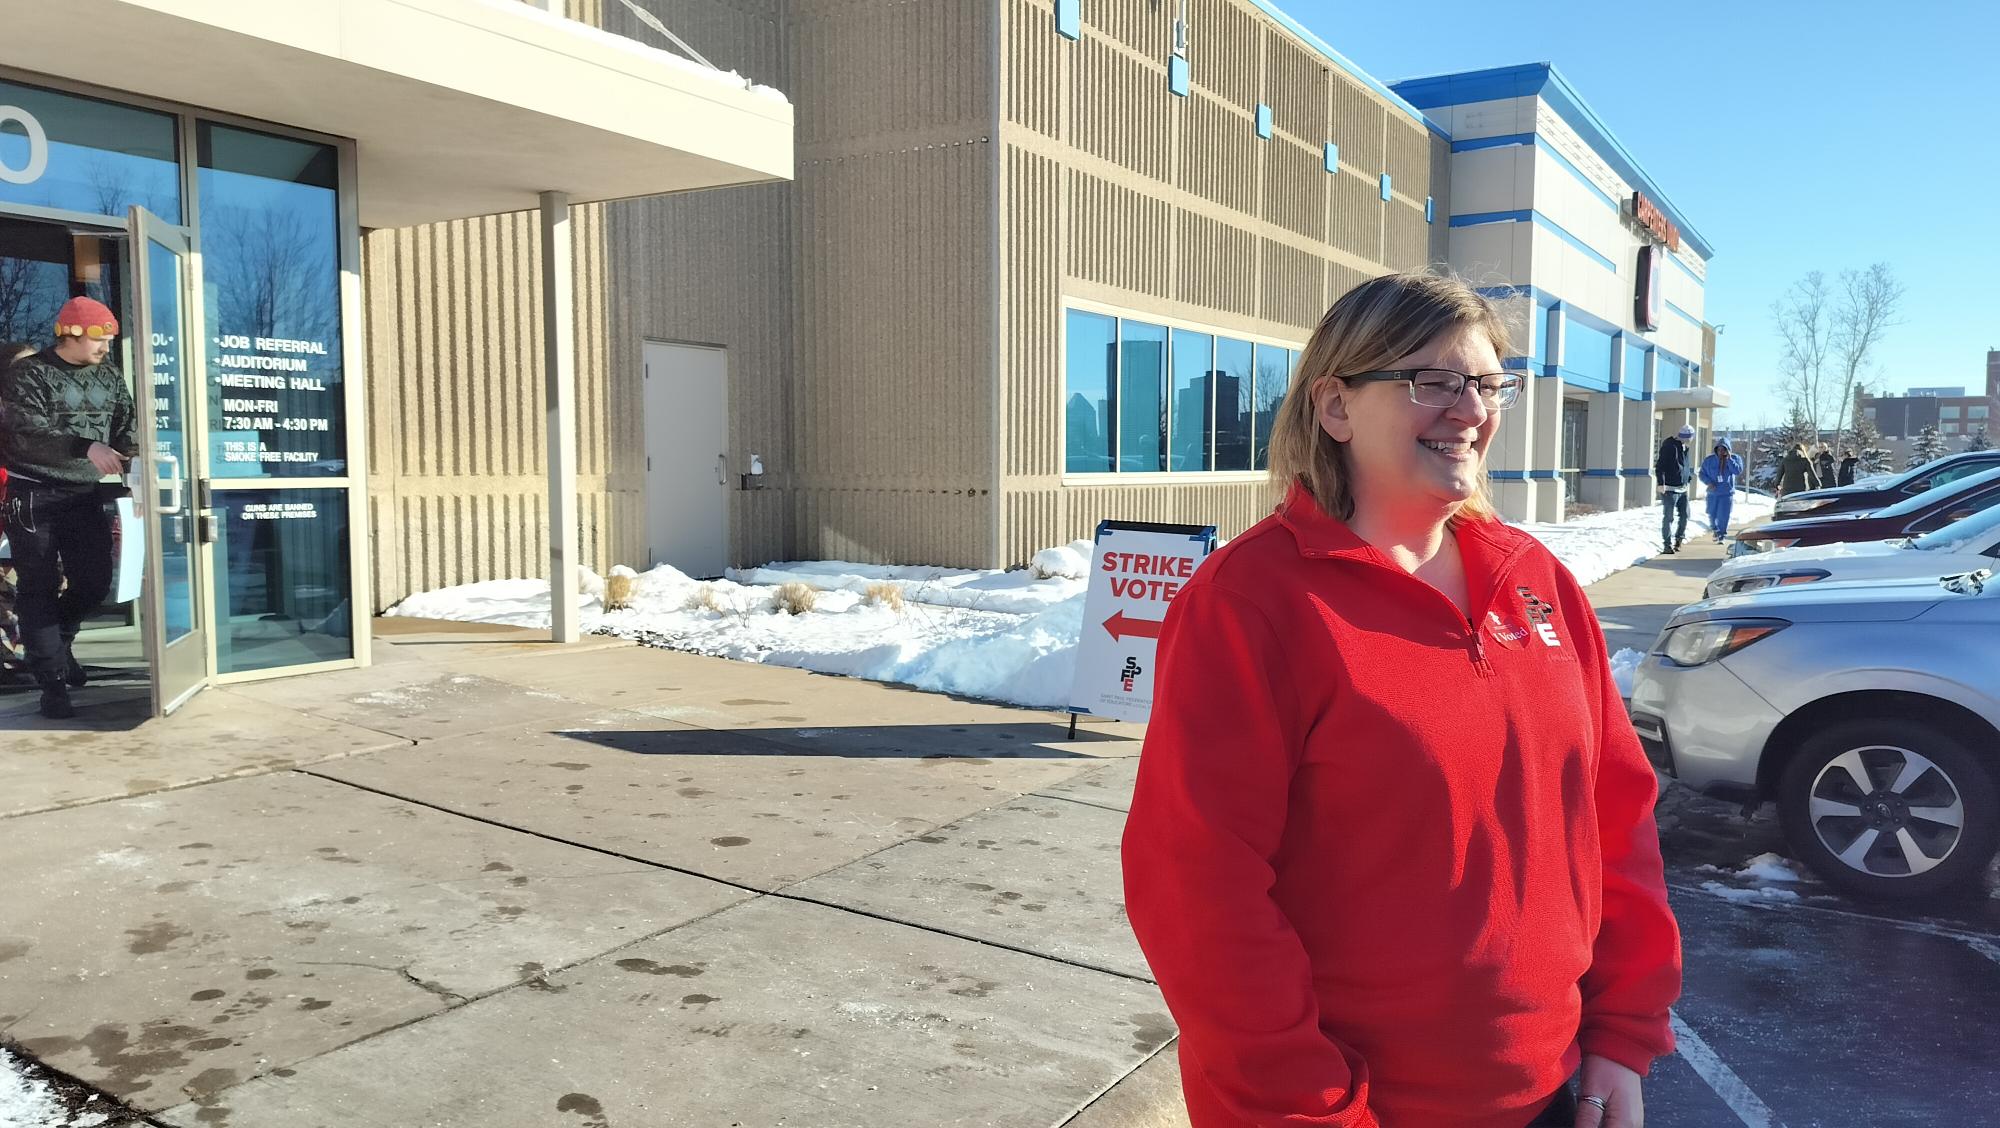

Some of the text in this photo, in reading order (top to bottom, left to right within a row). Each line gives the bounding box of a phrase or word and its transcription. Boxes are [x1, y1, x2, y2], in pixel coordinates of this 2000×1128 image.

[220, 335, 327, 355] JOB REFERRAL
[221, 355, 308, 372] AUDITORIUM
[221, 374, 326, 391] MEETING HALL
[224, 399, 279, 413] MON-FRI
[223, 416, 251, 430] 7:30
[253, 417, 274, 430] AM
[283, 418, 308, 431] 4:30
[309, 418, 329, 431] PM
[224, 441, 267, 452] THIS IS A
[224, 451, 319, 463] SMOKE FREE FACILITY
[244, 504, 267, 513] GUNS
[268, 503, 284, 512] ARE
[242, 512, 255, 520] ON
[1102, 551, 1195, 578] STRIKE
[1110, 577, 1179, 602] VOTE
[1497, 626, 1529, 642] Voted
